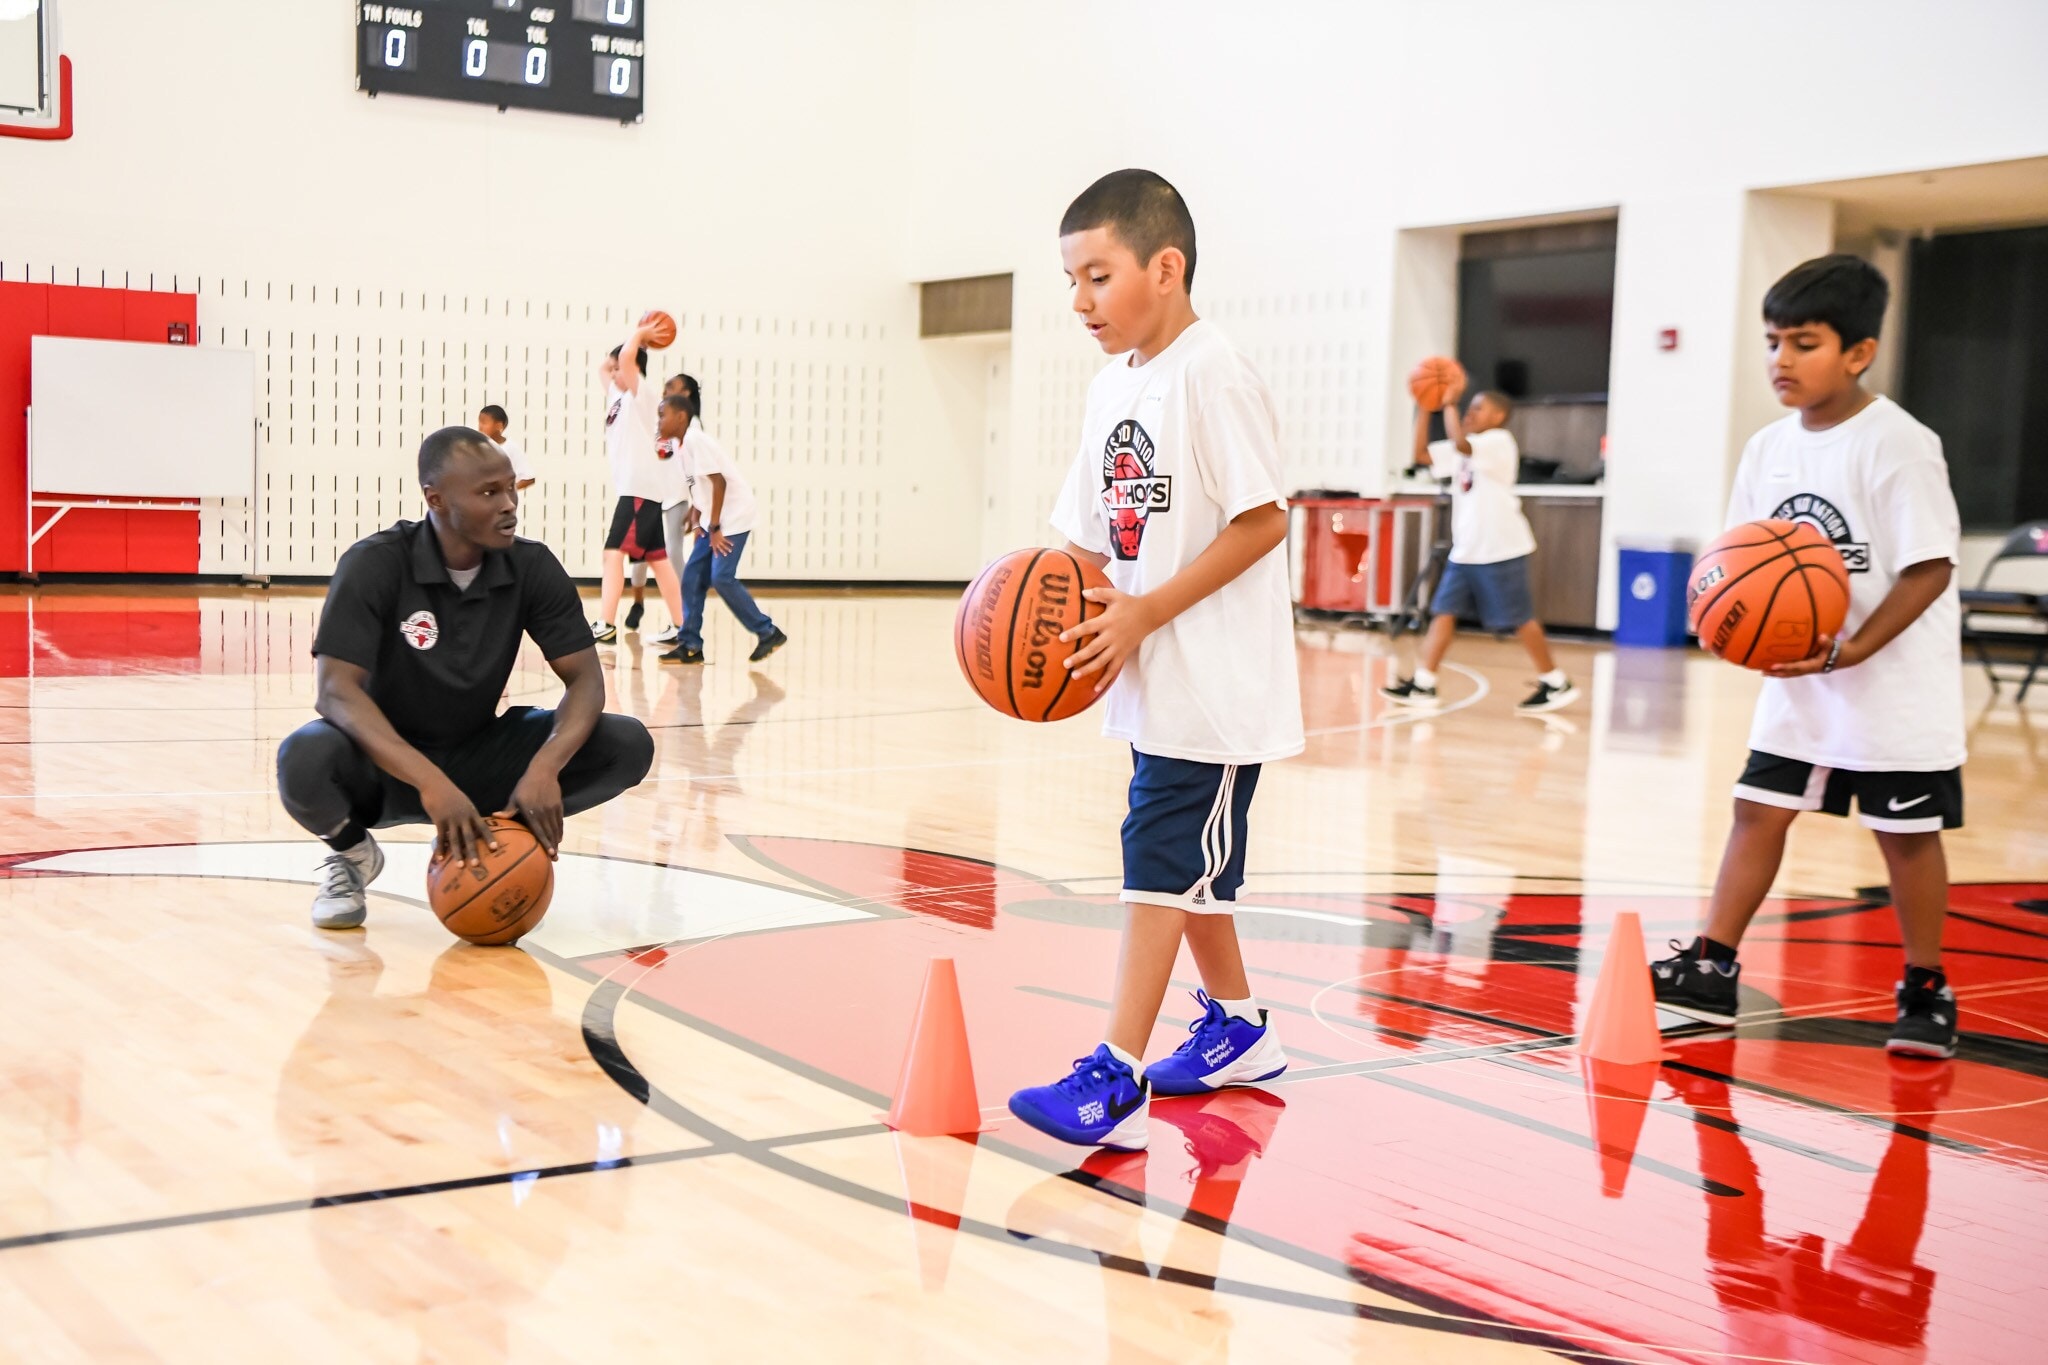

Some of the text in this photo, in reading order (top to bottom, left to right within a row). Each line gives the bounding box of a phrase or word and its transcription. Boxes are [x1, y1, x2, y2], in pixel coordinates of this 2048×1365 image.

[363, 3, 423, 29] TM FOULS
[466, 17, 490, 37] TOL
[525, 25, 549, 45] TOL
[384, 29, 407, 67] 0
[465, 39, 488, 77] 0
[524, 47, 547, 85] 0
[608, 57, 631, 95] 0
[1021, 573, 1071, 690] Wilson
